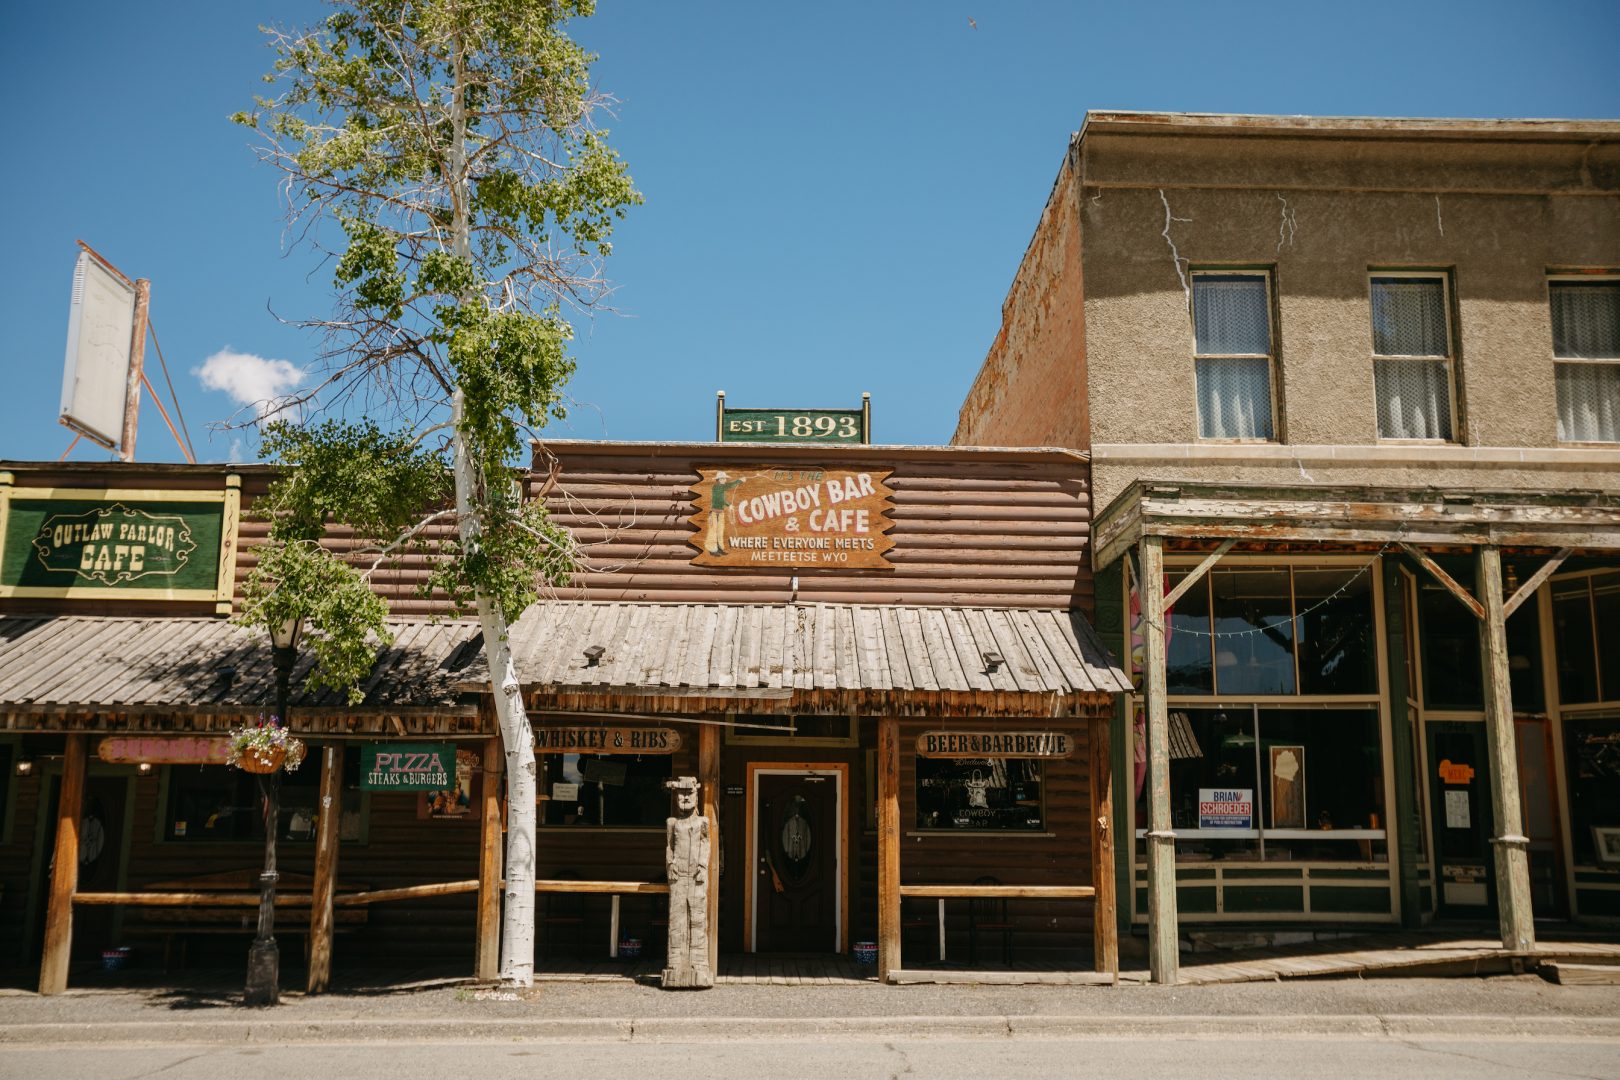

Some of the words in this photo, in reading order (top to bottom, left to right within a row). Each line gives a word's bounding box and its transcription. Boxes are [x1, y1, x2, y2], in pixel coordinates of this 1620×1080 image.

[729, 420, 766, 432] EST
[773, 415, 858, 438] 1893
[800, 471, 823, 481] THE
[738, 483, 821, 524] COWBOY
[826, 473, 876, 504] BAR
[785, 516, 800, 532] &
[809, 509, 870, 533] CAFE
[53, 523, 114, 548] OUTLAW
[119, 523, 175, 552] PARLOR
[729, 536, 768, 549] WHERE
[773, 537, 830, 550] EVERYONE
[835, 538, 875, 550] MEETS
[80, 544, 145, 571] CAFE
[750, 551, 818, 562] MEETEETSE
[822, 552, 848, 562] WYO
[535, 730, 608, 748] WHISKEY
[613, 731, 624, 748] &
[630, 730, 668, 748] RIBS
[373, 752, 445, 773] PIZZA
[368, 772, 400, 785] STEAKS
[1213, 791, 1238, 802] BRIAN
[1201, 802, 1250, 815] SCHROEDER
